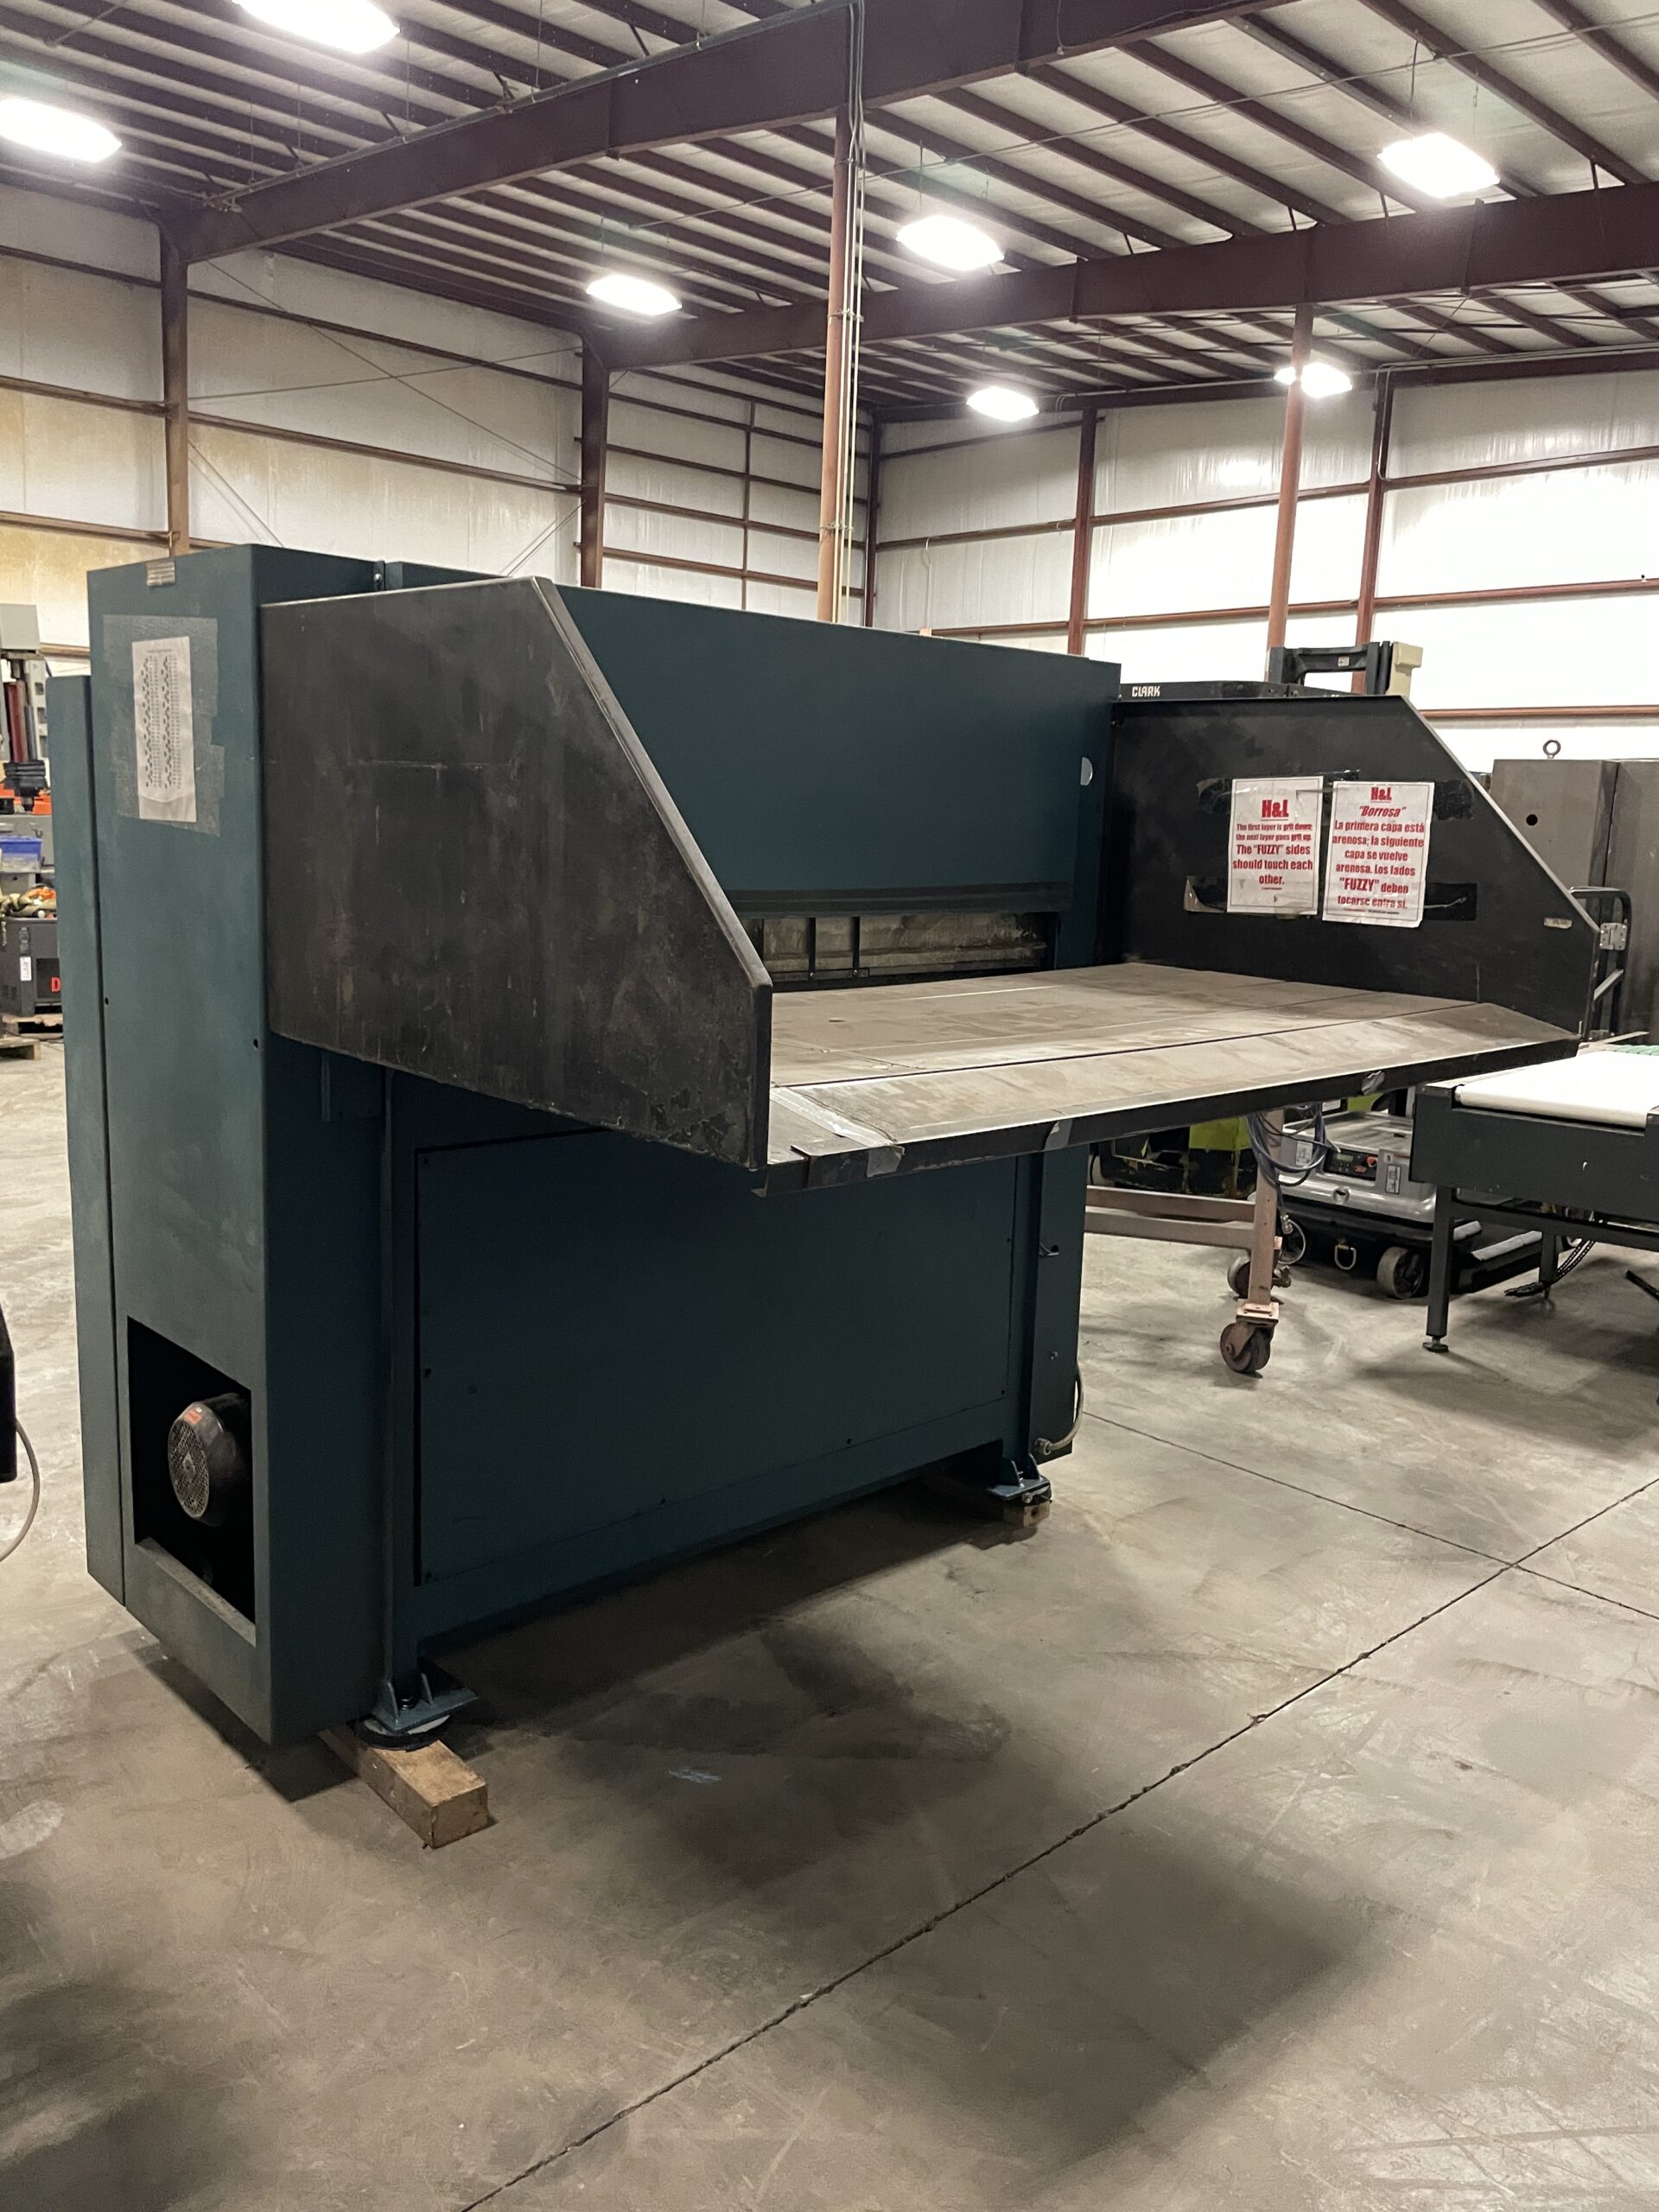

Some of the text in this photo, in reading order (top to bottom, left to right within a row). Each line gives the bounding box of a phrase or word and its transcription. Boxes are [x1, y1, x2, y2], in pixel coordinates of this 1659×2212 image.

[1132, 685, 1161, 697] CLARK
[1370, 787, 1392, 801] H&L
[1262, 799, 1289, 818] H&L
[1359, 805, 1407, 817] "Borrosa"
[1248, 823, 1261, 831] first
[1262, 823, 1276, 832] layer
[1283, 823, 1294, 832] grit
[1334, 820, 1425, 833] La primera capa está
[1332, 836, 1425, 848] arenosa; la siguiente
[1236, 844, 1311, 855] The "FUZZY" sides
[1344, 850, 1408, 861] capa se vuelve
[1233, 859, 1313, 870] should touch each
[1336, 864, 1415, 876] arenosa. Los lados
[1259, 874, 1285, 885] other.
[1339, 877, 1409, 893] "FUZZY" deben
[1338, 895, 1370, 906] tocarse
